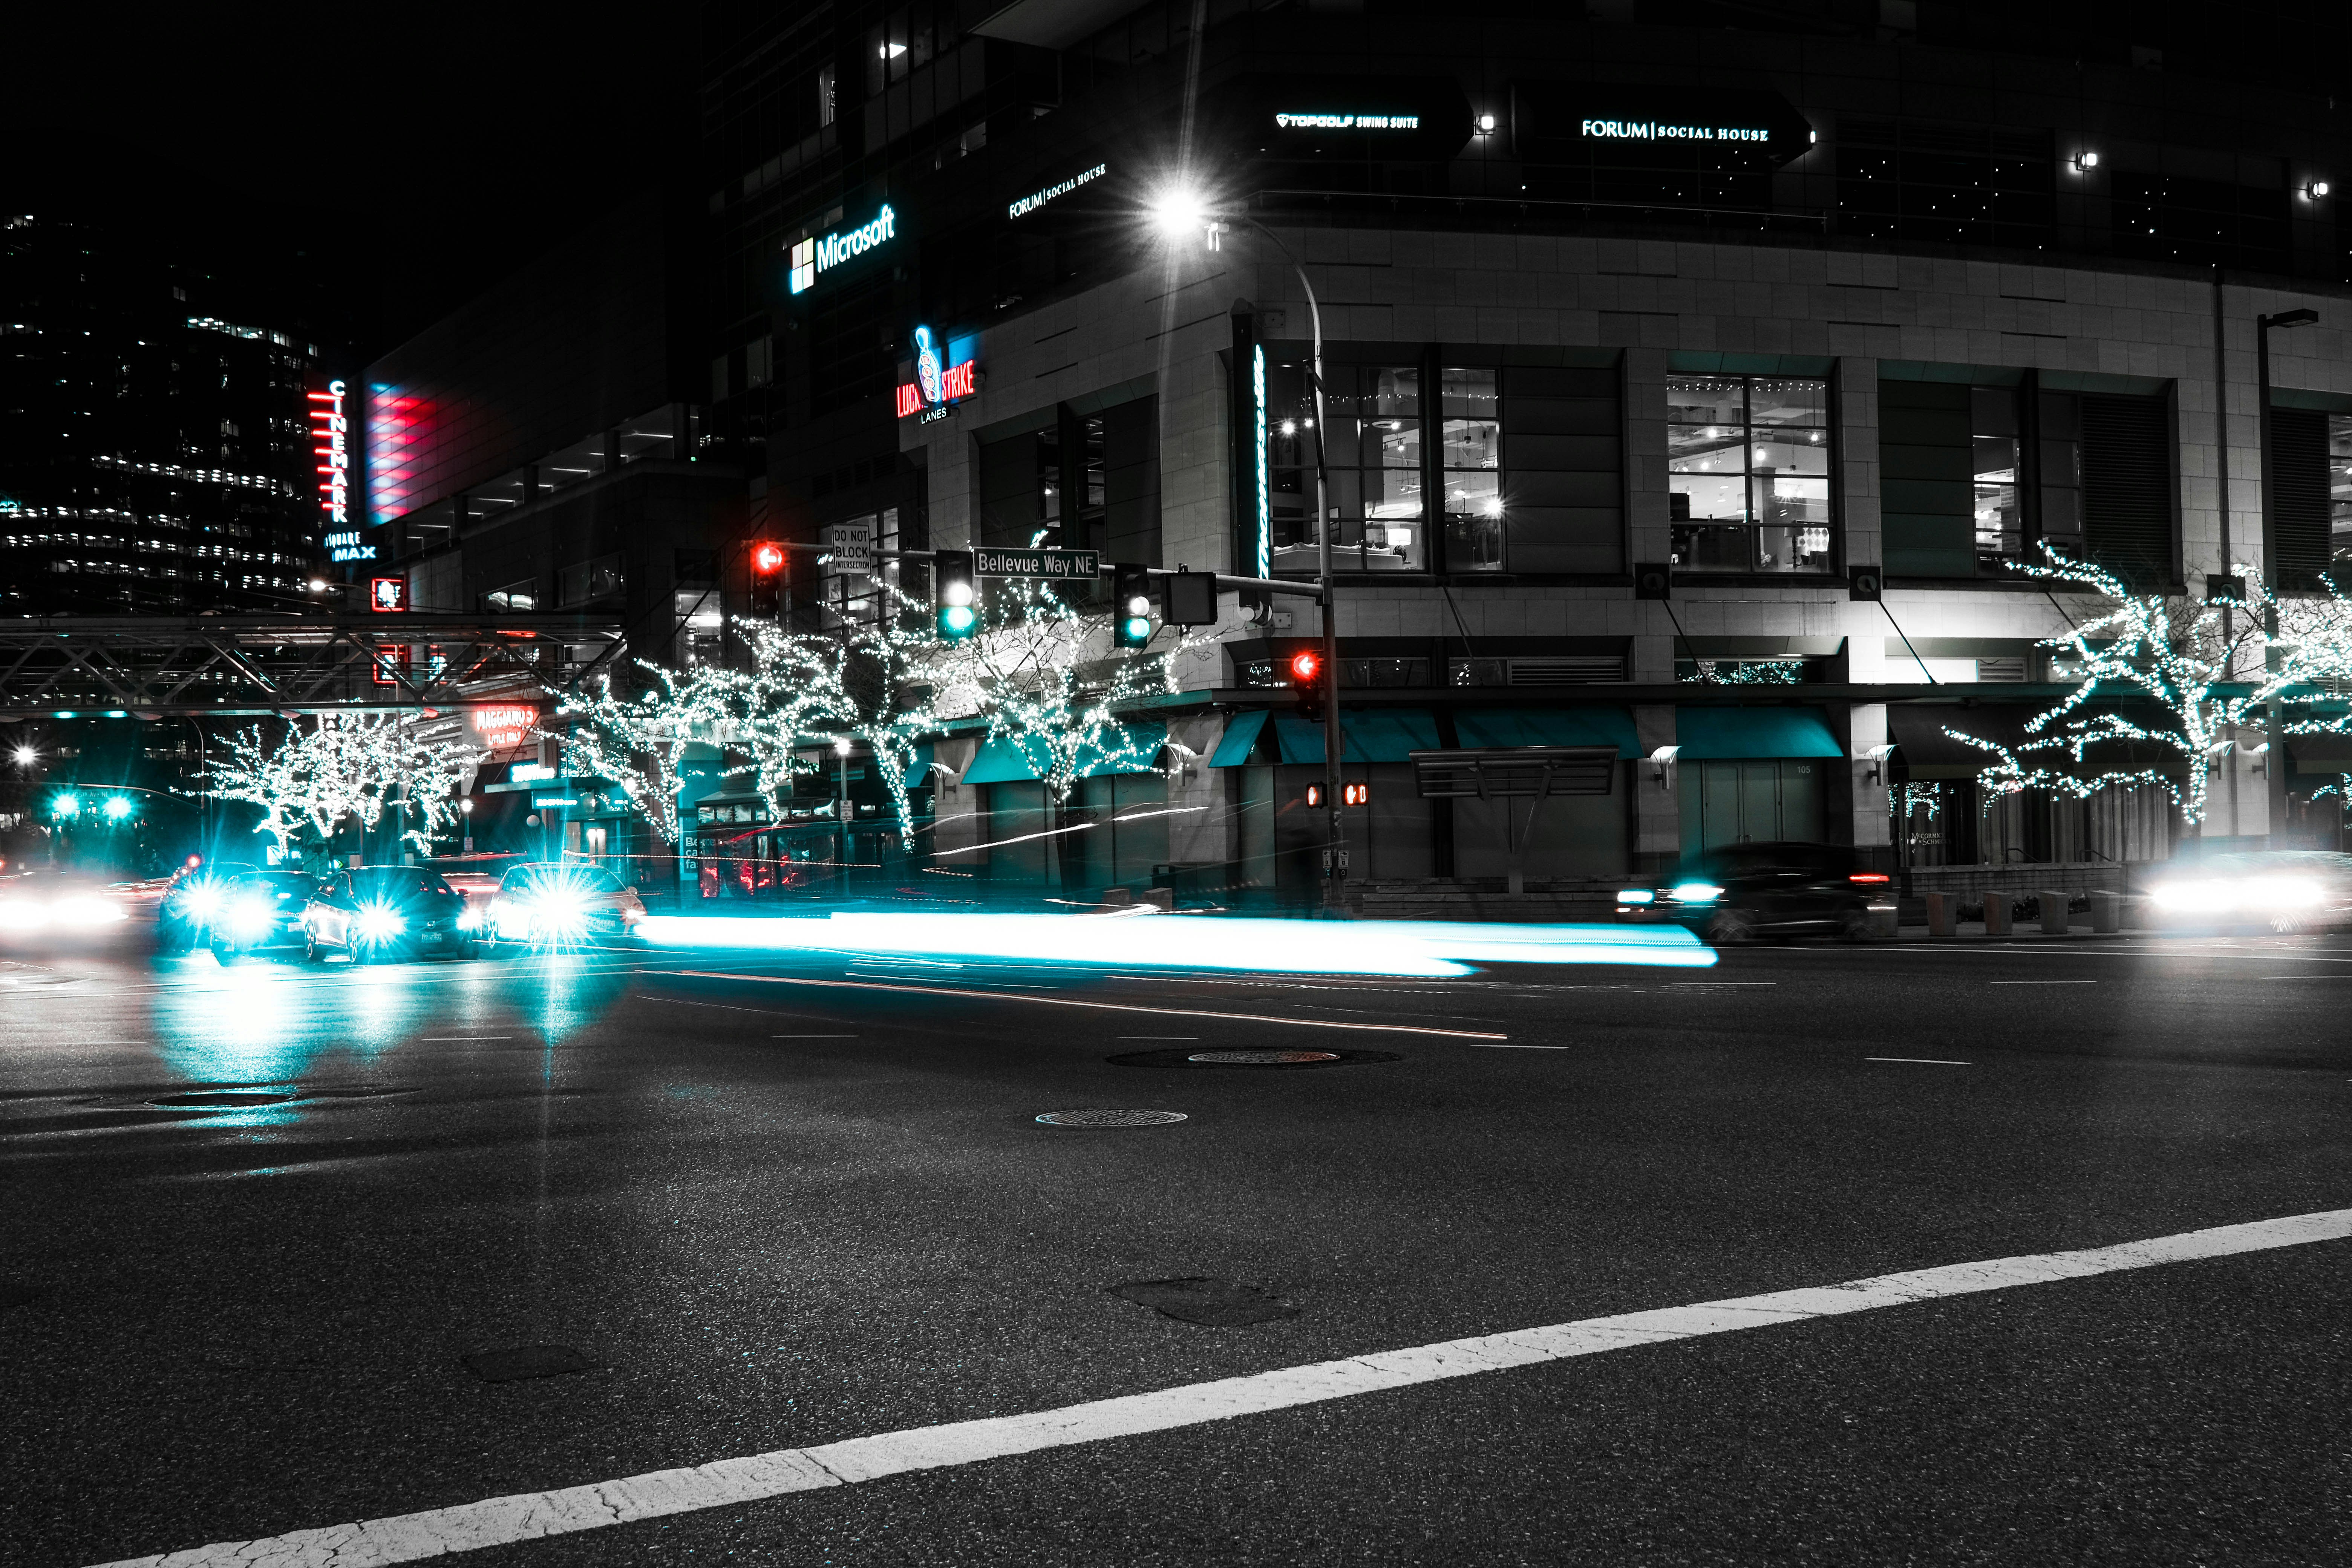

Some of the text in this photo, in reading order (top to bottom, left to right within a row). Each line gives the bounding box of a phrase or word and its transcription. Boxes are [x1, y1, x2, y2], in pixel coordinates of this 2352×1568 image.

[1289, 115, 1418, 129] TOPGOLF SWING SUITE
[1582, 121, 1768, 141] FORUM SOCIAL HOUSE
[1010, 164, 1106, 219] FORUM SOCIAL HOUSE
[817, 204, 895, 273] Microsoft
[897, 360, 974, 418] LUCK STRIKE
[921, 407, 946, 424] LANES
[330, 381, 348, 522] CINEMARK
[1254, 345, 1269, 580] Thomasville
[328, 531, 360, 548] SQUARE
[835, 530, 867, 542] DO NOT
[332, 547, 376, 562] IMAX
[836, 547, 868, 558] BLOCK
[836, 561, 869, 569] INTERSECTION
[978, 553, 1094, 577] Bellevue Way NE
[506, 731, 522, 743] ITALY
[1797, 766, 1811, 774] 105
